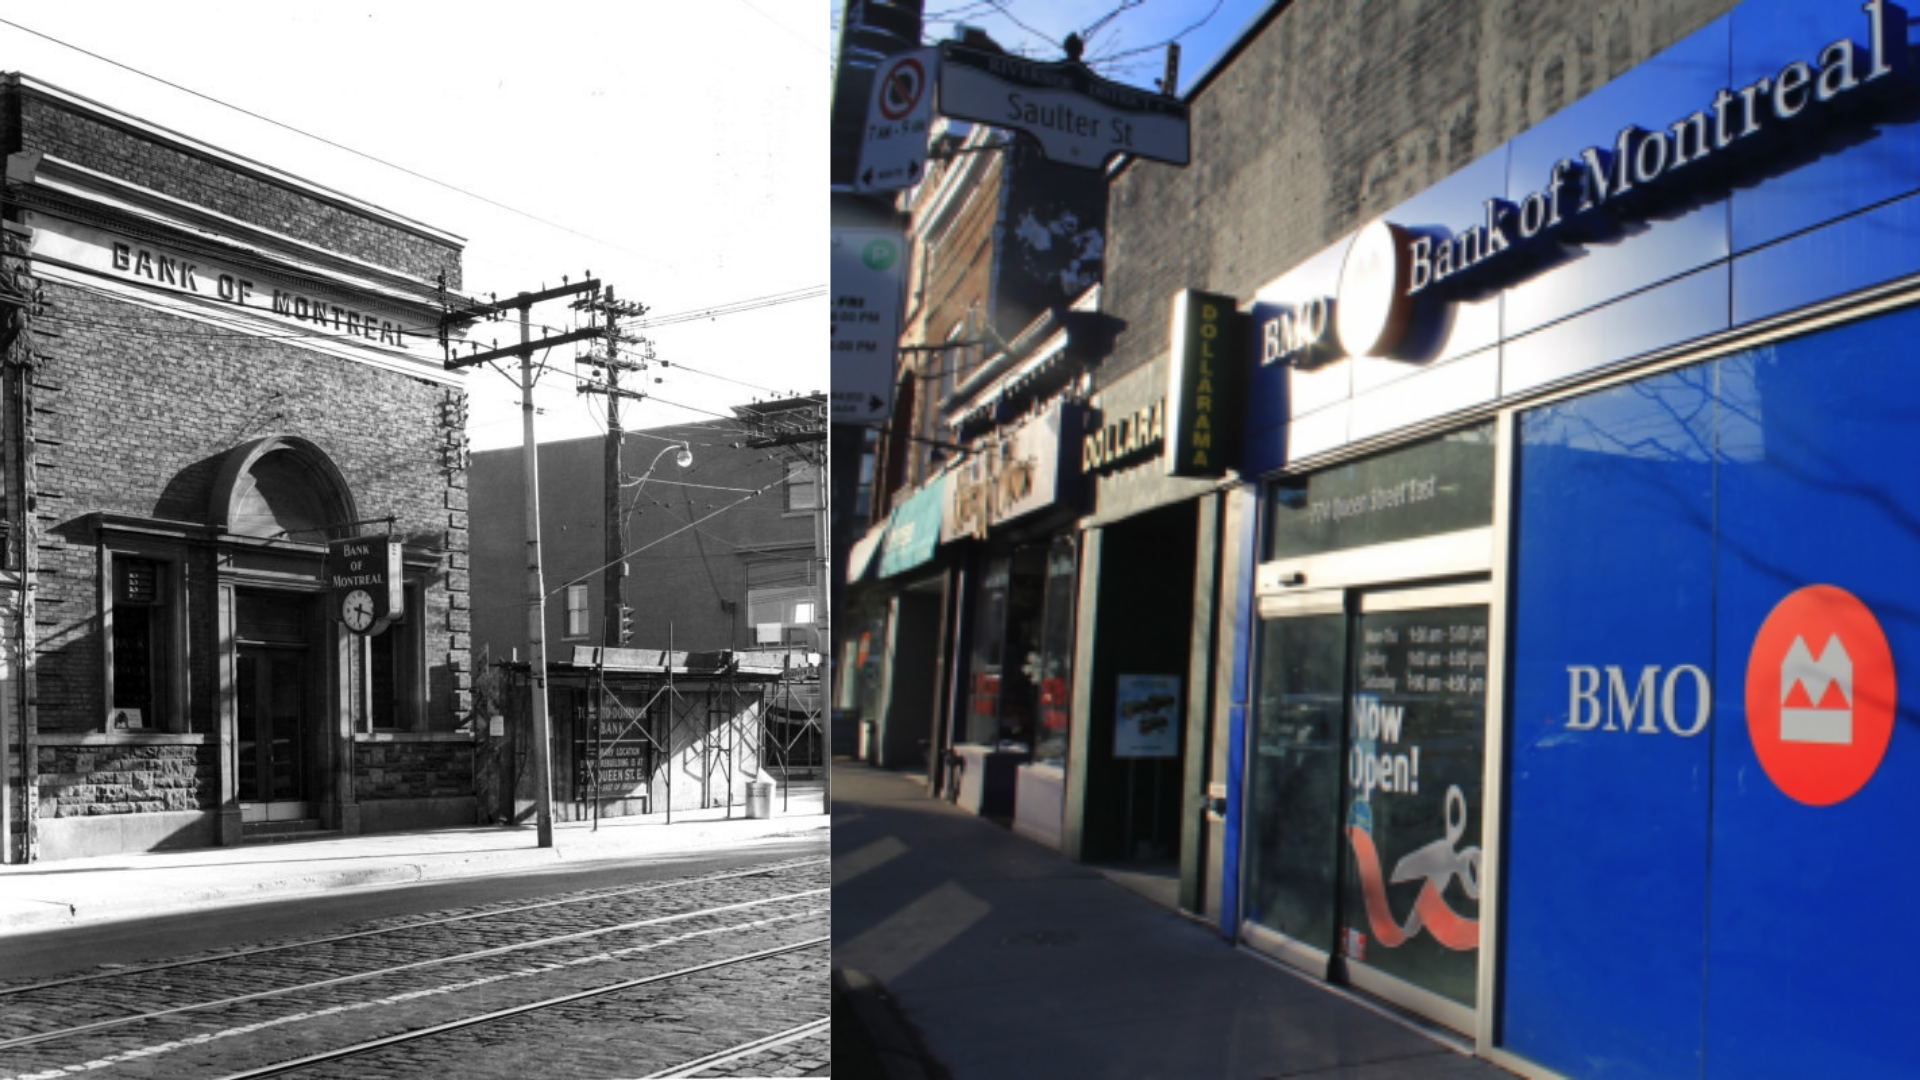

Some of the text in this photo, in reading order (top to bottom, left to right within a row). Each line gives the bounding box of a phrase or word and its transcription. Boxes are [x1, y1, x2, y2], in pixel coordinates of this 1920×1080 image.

[1006, 92, 1133, 146] Saulter St
[1407, 199, 1509, 295] Bank
[1520, 157, 1572, 239] of
[1579, 0, 1893, 213] Montreal
[111, 241, 408, 349] BANK OF MONTREAL
[1261, 297, 1328, 367] BMO
[1193, 304, 1218, 468] DOLLARAMA
[1352, 695, 1405, 745] Now
[1564, 663, 1712, 738] BMO
[1349, 744, 1421, 802] Open!
